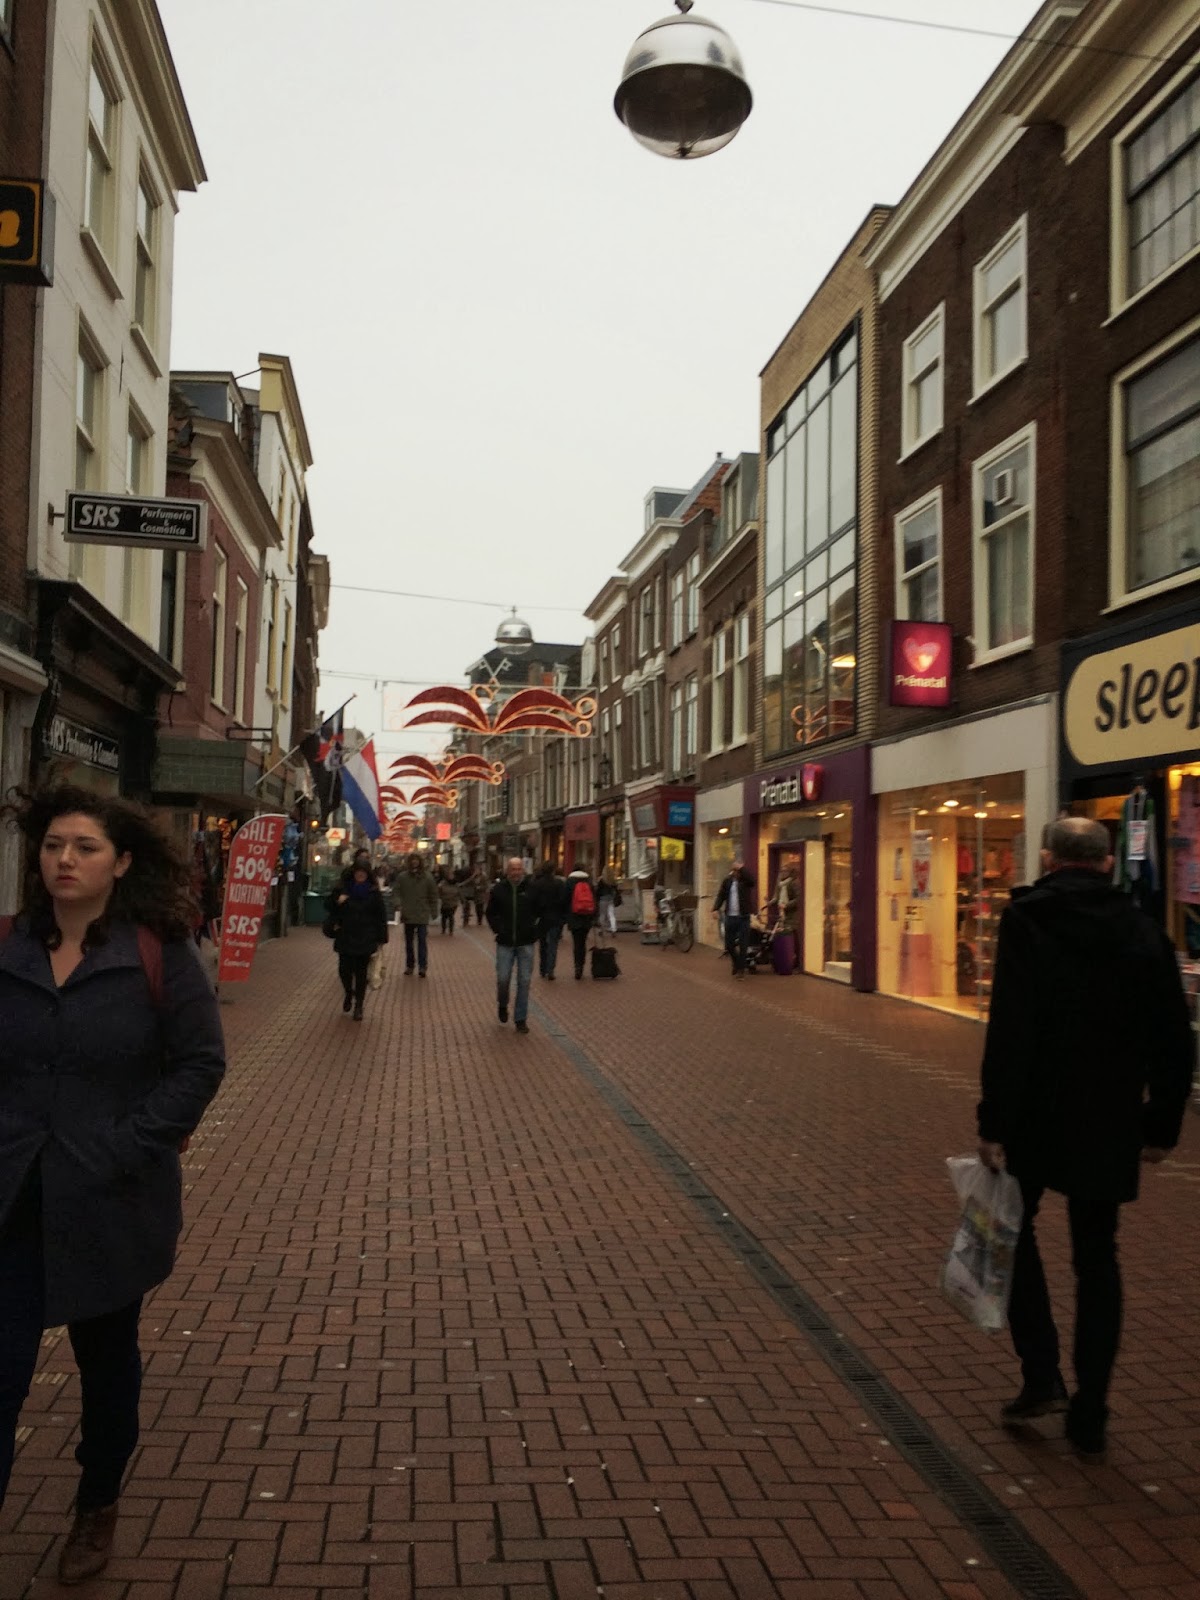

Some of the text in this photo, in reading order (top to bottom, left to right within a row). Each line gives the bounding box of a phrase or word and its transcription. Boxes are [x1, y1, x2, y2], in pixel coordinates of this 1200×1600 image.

[79, 504, 121, 528] SRS
[140, 507, 192, 521] Parfumerie
[239, 821, 277, 844] SALE
[248, 844, 269, 855] TOT
[233, 856, 272, 882] 50%
[228, 882, 268, 905] KORTING
[226, 914, 261, 936] SRS
